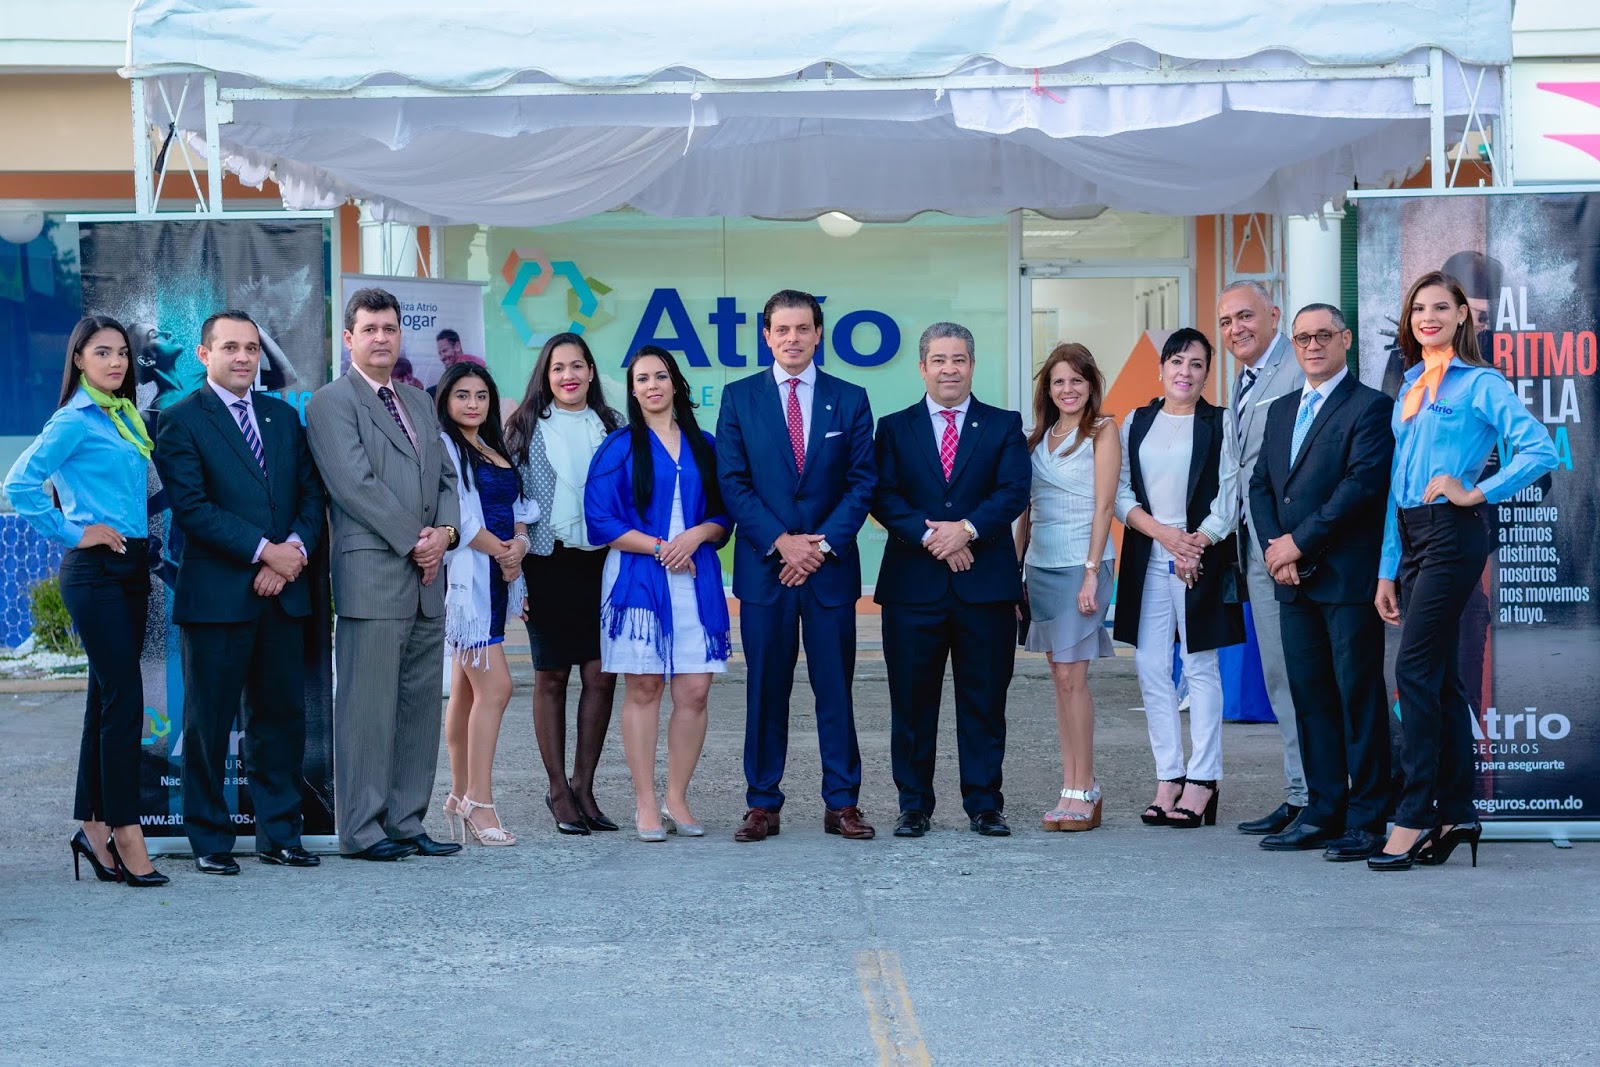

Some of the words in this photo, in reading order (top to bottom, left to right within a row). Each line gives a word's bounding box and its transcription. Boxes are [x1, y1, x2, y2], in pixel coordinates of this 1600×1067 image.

[416, 303, 438, 312] Atrio
[1495, 286, 1536, 331] AL
[402, 314, 437, 331] ogar
[1493, 330, 1597, 377] RITMO
[1426, 403, 1453, 415] Atrio
[1542, 378, 1581, 424] LA
[1515, 485, 1543, 502] vida
[1498, 505, 1511, 523] te
[1513, 506, 1558, 522] mueve
[1498, 527, 1507, 543] a
[1509, 524, 1553, 543] ritmos
[1498, 544, 1560, 565] distintos,
[1499, 565, 1557, 583] nosotros
[1499, 587, 1523, 603] nos
[1525, 586, 1590, 603] movemos
[1500, 605, 1512, 623] al
[1513, 605, 1547, 625] tuyo.
[1472, 743, 1539, 755] SEGUROS
[1481, 761, 1505, 773] para
[1507, 760, 1565, 772] asegurarte
[1472, 795, 1584, 813] seguros.com.do
